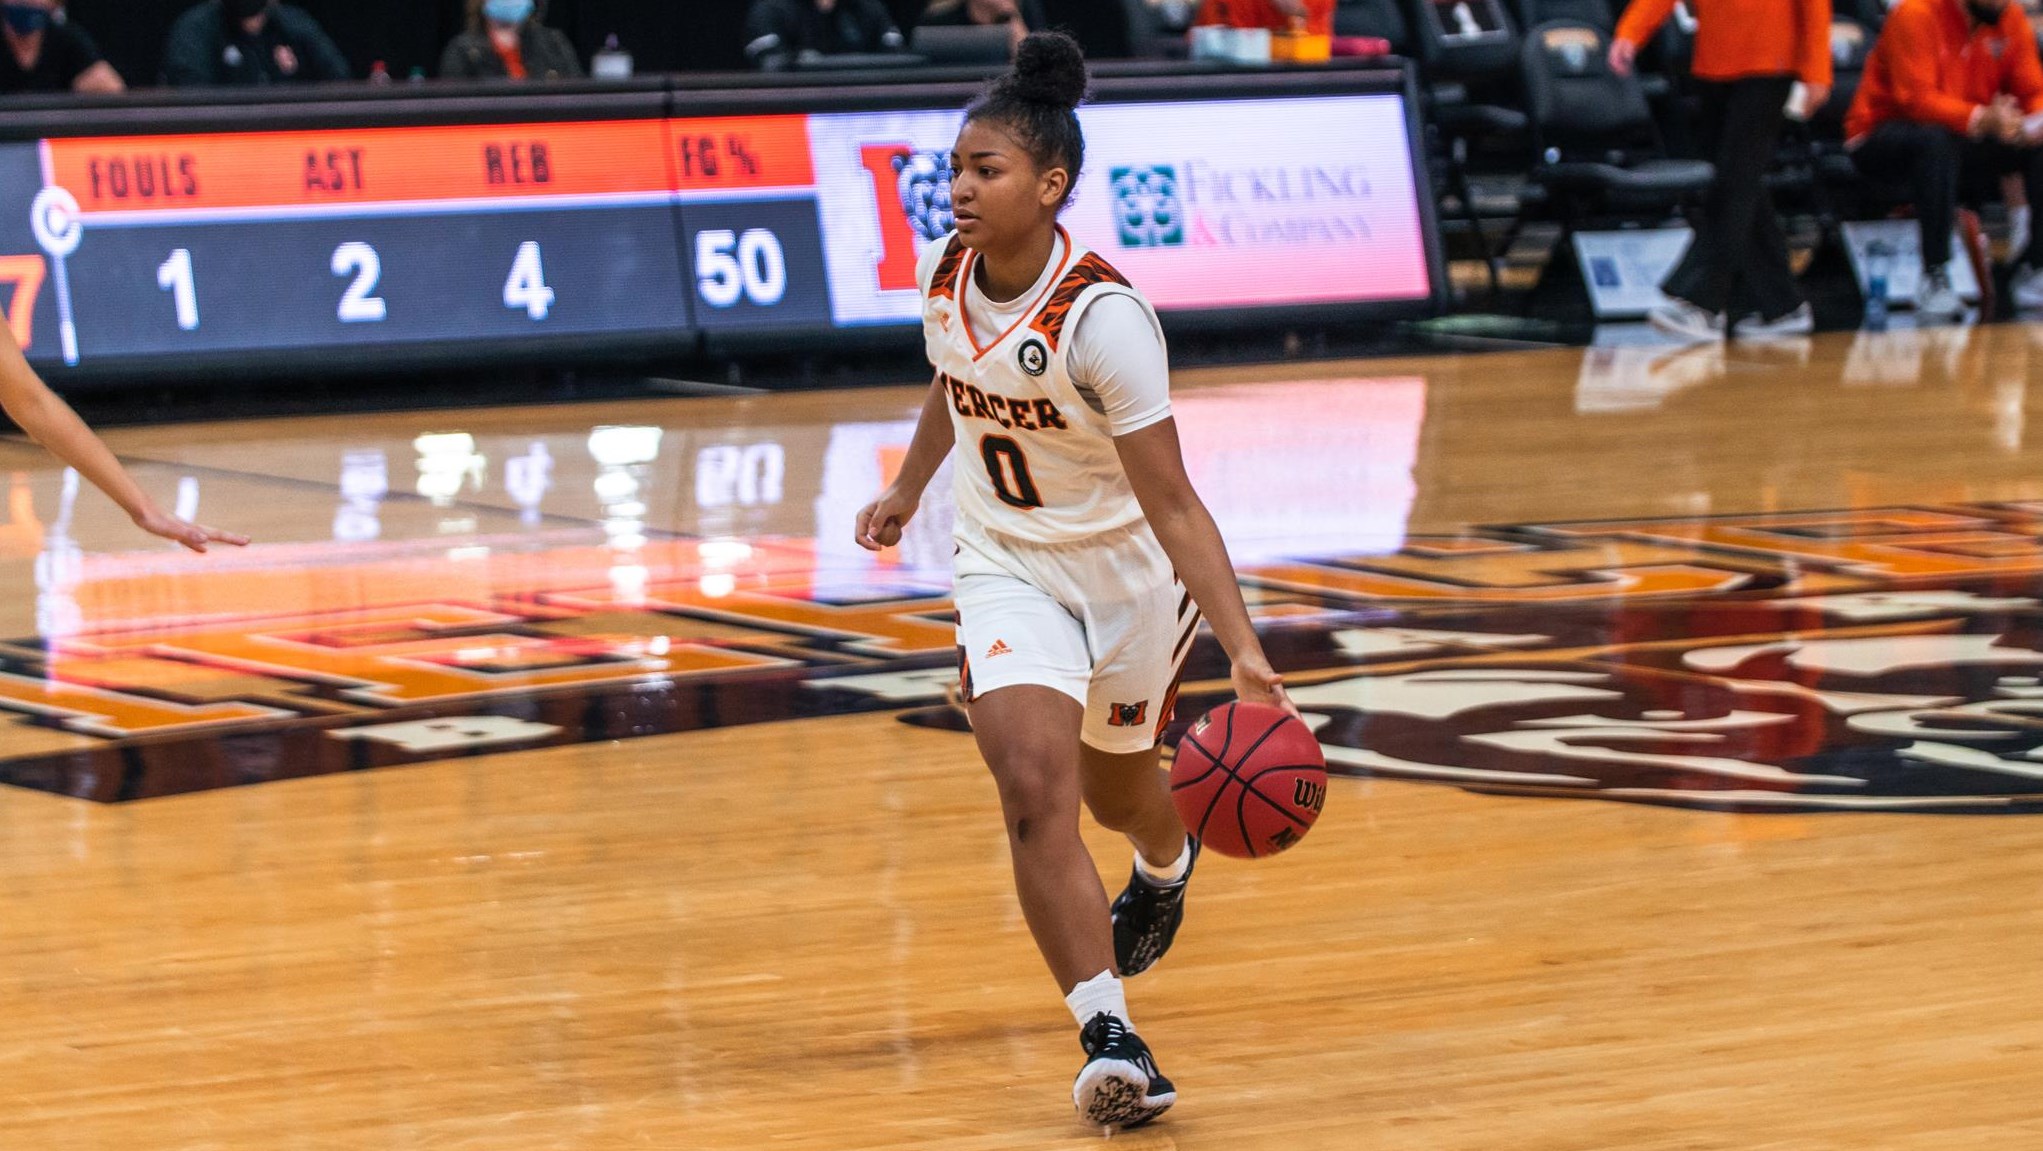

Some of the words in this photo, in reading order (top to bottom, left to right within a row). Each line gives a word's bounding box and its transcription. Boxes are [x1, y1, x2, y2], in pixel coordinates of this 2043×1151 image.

[88, 151, 197, 199] FOULS
[305, 148, 366, 190] AST
[484, 141, 551, 185] REB
[680, 136, 718, 177] FG
[157, 248, 199, 330] 1
[330, 241, 387, 323] 2
[503, 240, 555, 320] 4
[694, 227, 787, 307] 50
[979, 432, 1044, 511] 0
